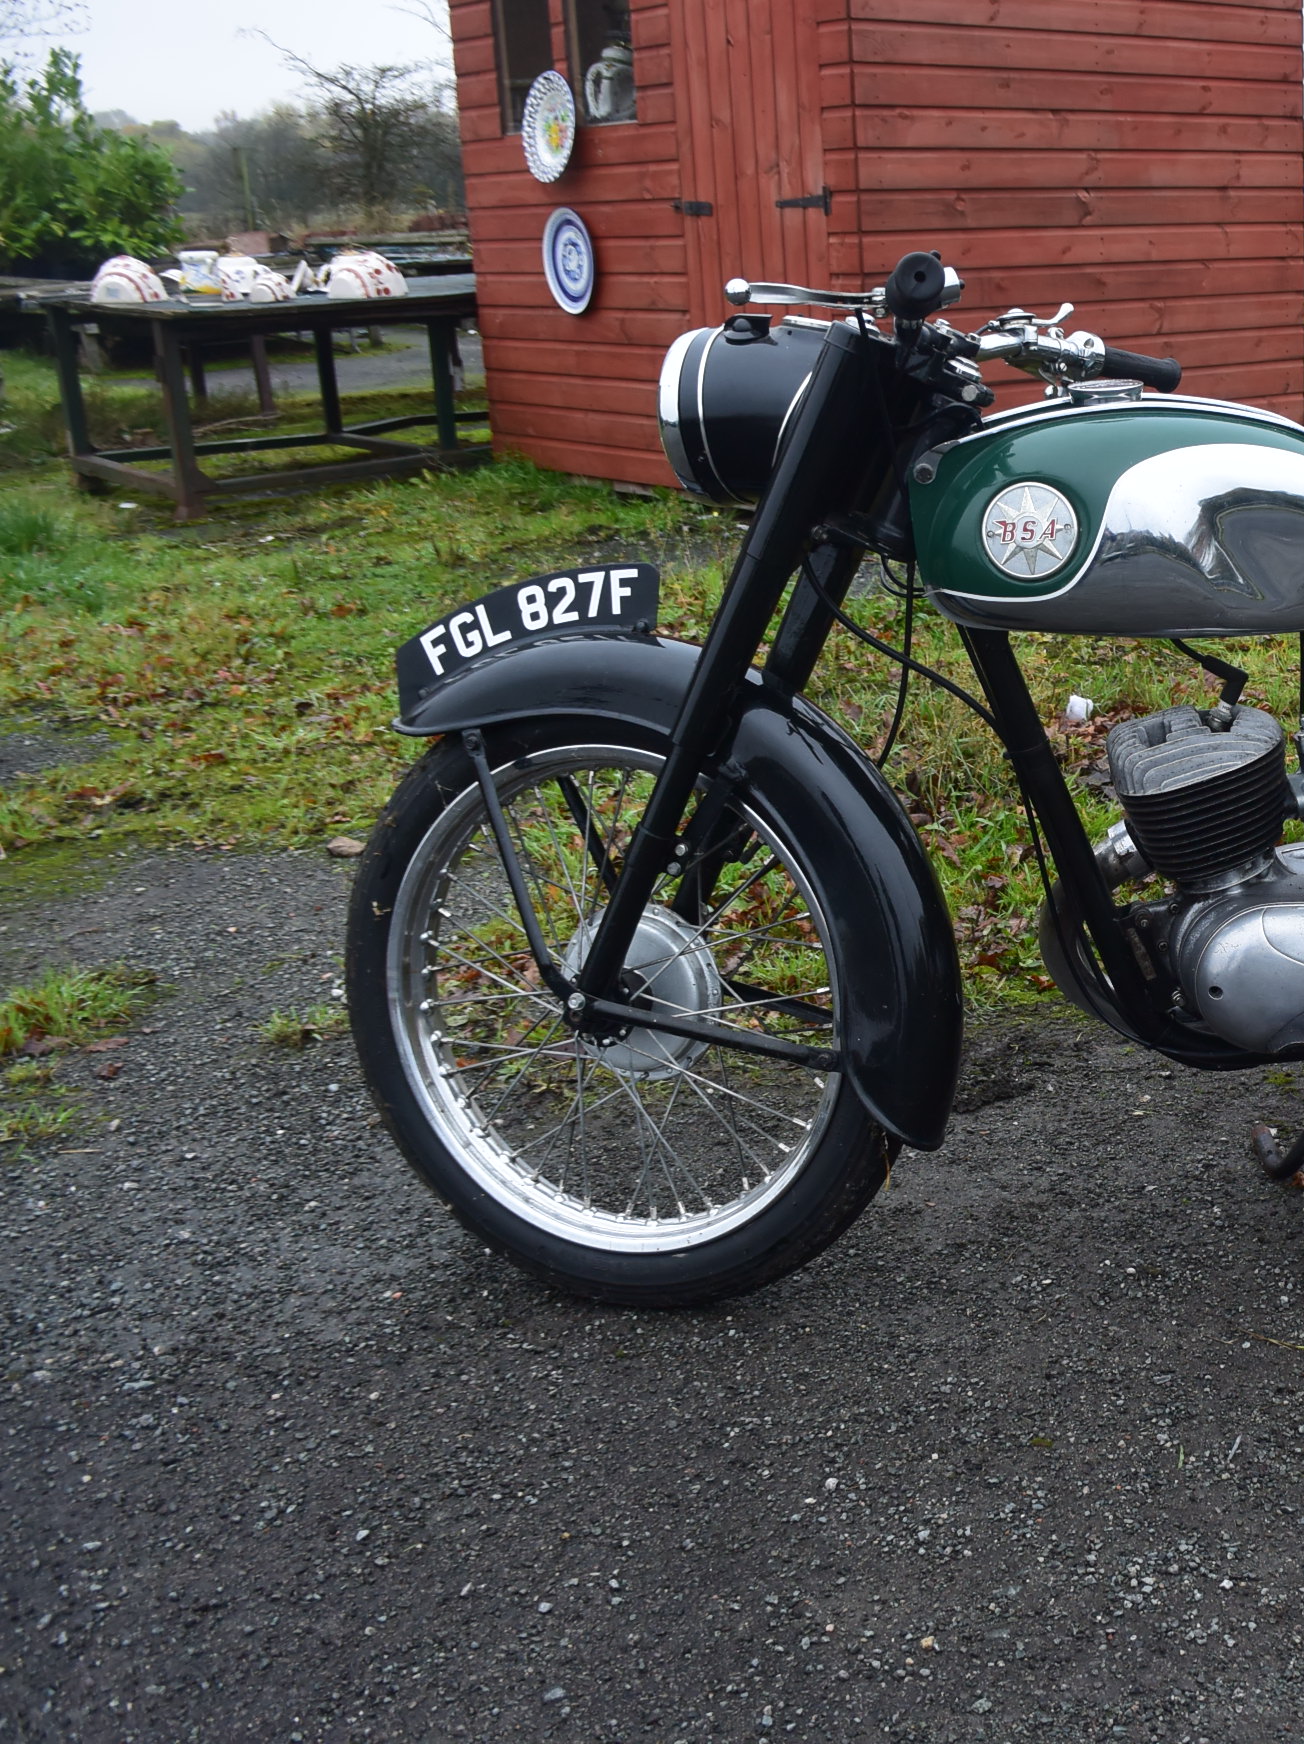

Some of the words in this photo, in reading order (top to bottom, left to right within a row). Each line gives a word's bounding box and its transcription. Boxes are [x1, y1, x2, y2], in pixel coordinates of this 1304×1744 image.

[992, 519, 1057, 544] BSA
[419, 603, 512, 676] FGL
[517, 568, 639, 631] 827F
